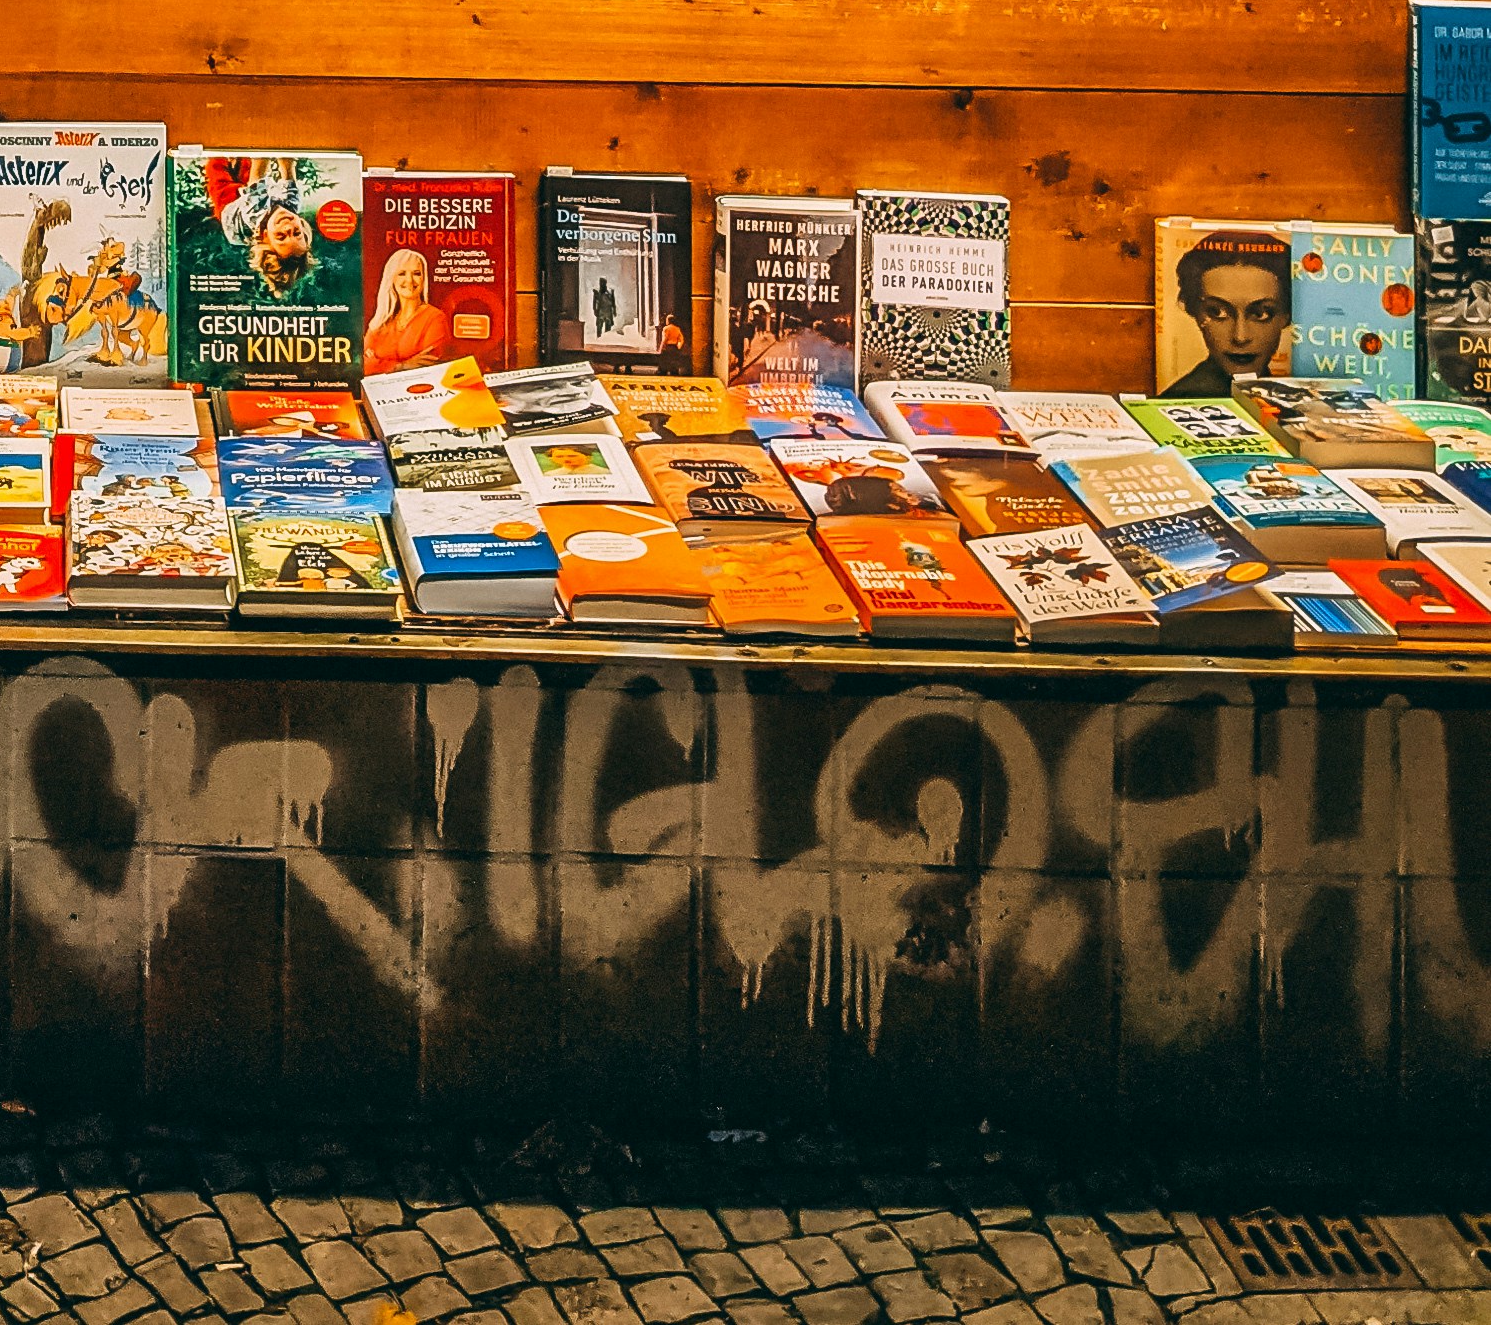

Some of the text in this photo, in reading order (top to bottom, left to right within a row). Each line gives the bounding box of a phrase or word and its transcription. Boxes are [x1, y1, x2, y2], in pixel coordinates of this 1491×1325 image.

[54, 131, 101, 147] Asterix
[110, 136, 159, 147] UDERZO
[66, 173, 84, 187] und
[83, 181, 100, 195] der
[99, 150, 161, 207] Greif
[385, 198, 493, 214] DIE BESSERE
[401, 215, 476, 230] MEDIZIN
[557, 209, 585, 223] Der
[556, 226, 677, 245] verborgene Sinn
[736, 219, 793, 234] HERFRIED
[425, 230, 493, 246] FRAUEN
[768, 237, 820, 257] MARX
[1312, 235, 1393, 256] SALLY
[889, 243, 986, 259] HEINRICH HEMME
[756, 260, 831, 280] WAGNER
[881, 258, 994, 277] DAS GROSSE BUCH
[1291, 262, 1415, 285] ROONEY
[747, 283, 840, 303] NIETZSCHE
[881, 274, 994, 294] DER PARADOXIEN
[198, 315, 329, 336] GESUNDHEIT
[199, 336, 352, 363] FÜR KINDER
[764, 356, 819, 372] WELT IM
[1315, 353, 1392, 378] WELT,
[890, 391, 992, 401] Animal
[230, 471, 381, 486] Papierflieger
[445, 473, 503, 488] AUGUST
[1086, 462, 1170, 481] Zadie
[1091, 475, 1183, 494] Smith
[1108, 488, 1193, 506] Zähne
[1106, 515, 1217, 547] FERRANTE
[1118, 515, 1190, 535] ELENA
[844, 560, 886, 571] This
[850, 568, 957, 582] Mournable
[859, 578, 906, 591] Body
